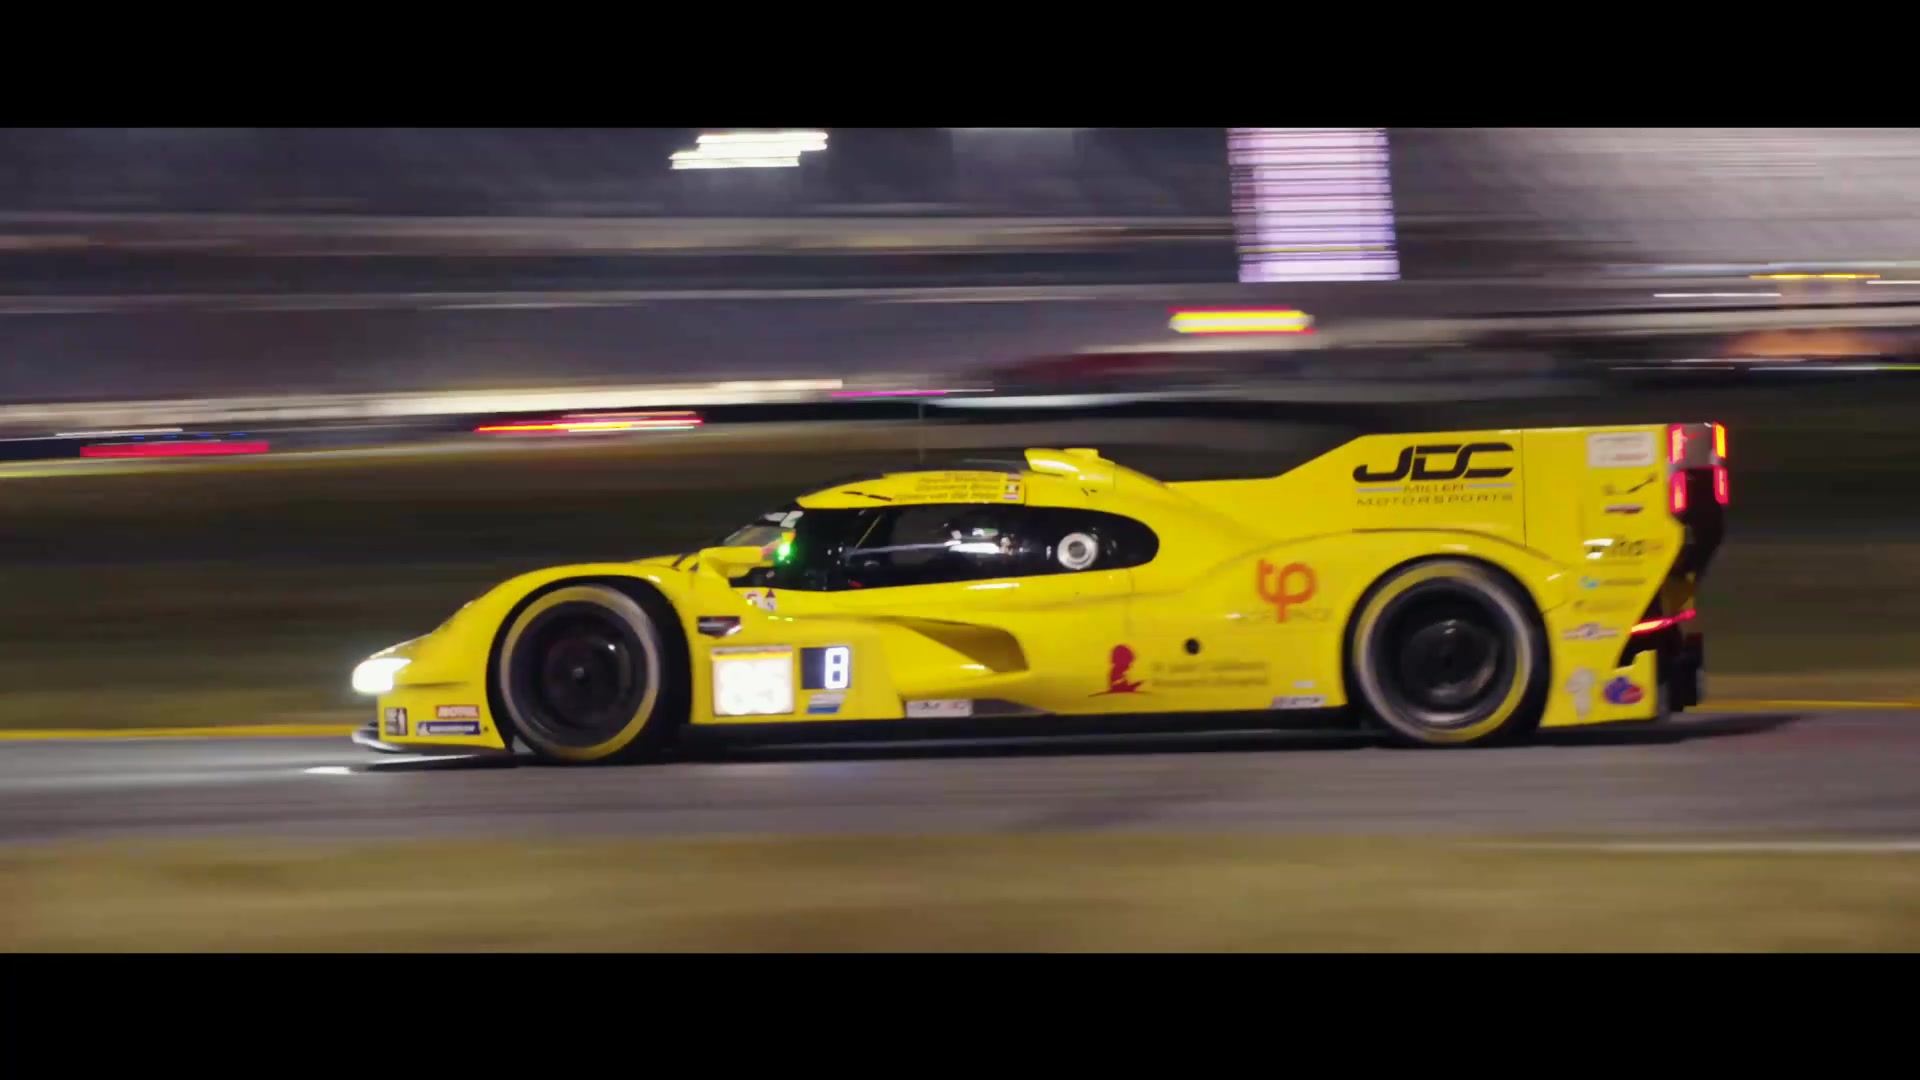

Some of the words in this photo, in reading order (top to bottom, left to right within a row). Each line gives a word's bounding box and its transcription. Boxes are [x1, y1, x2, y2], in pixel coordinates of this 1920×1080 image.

[1353, 442, 1514, 483] JDC
[1356, 494, 1513, 506] MOTORSPORTS
[1403, 484, 1465, 494] MILLER
[824, 647, 849, 689] 8
